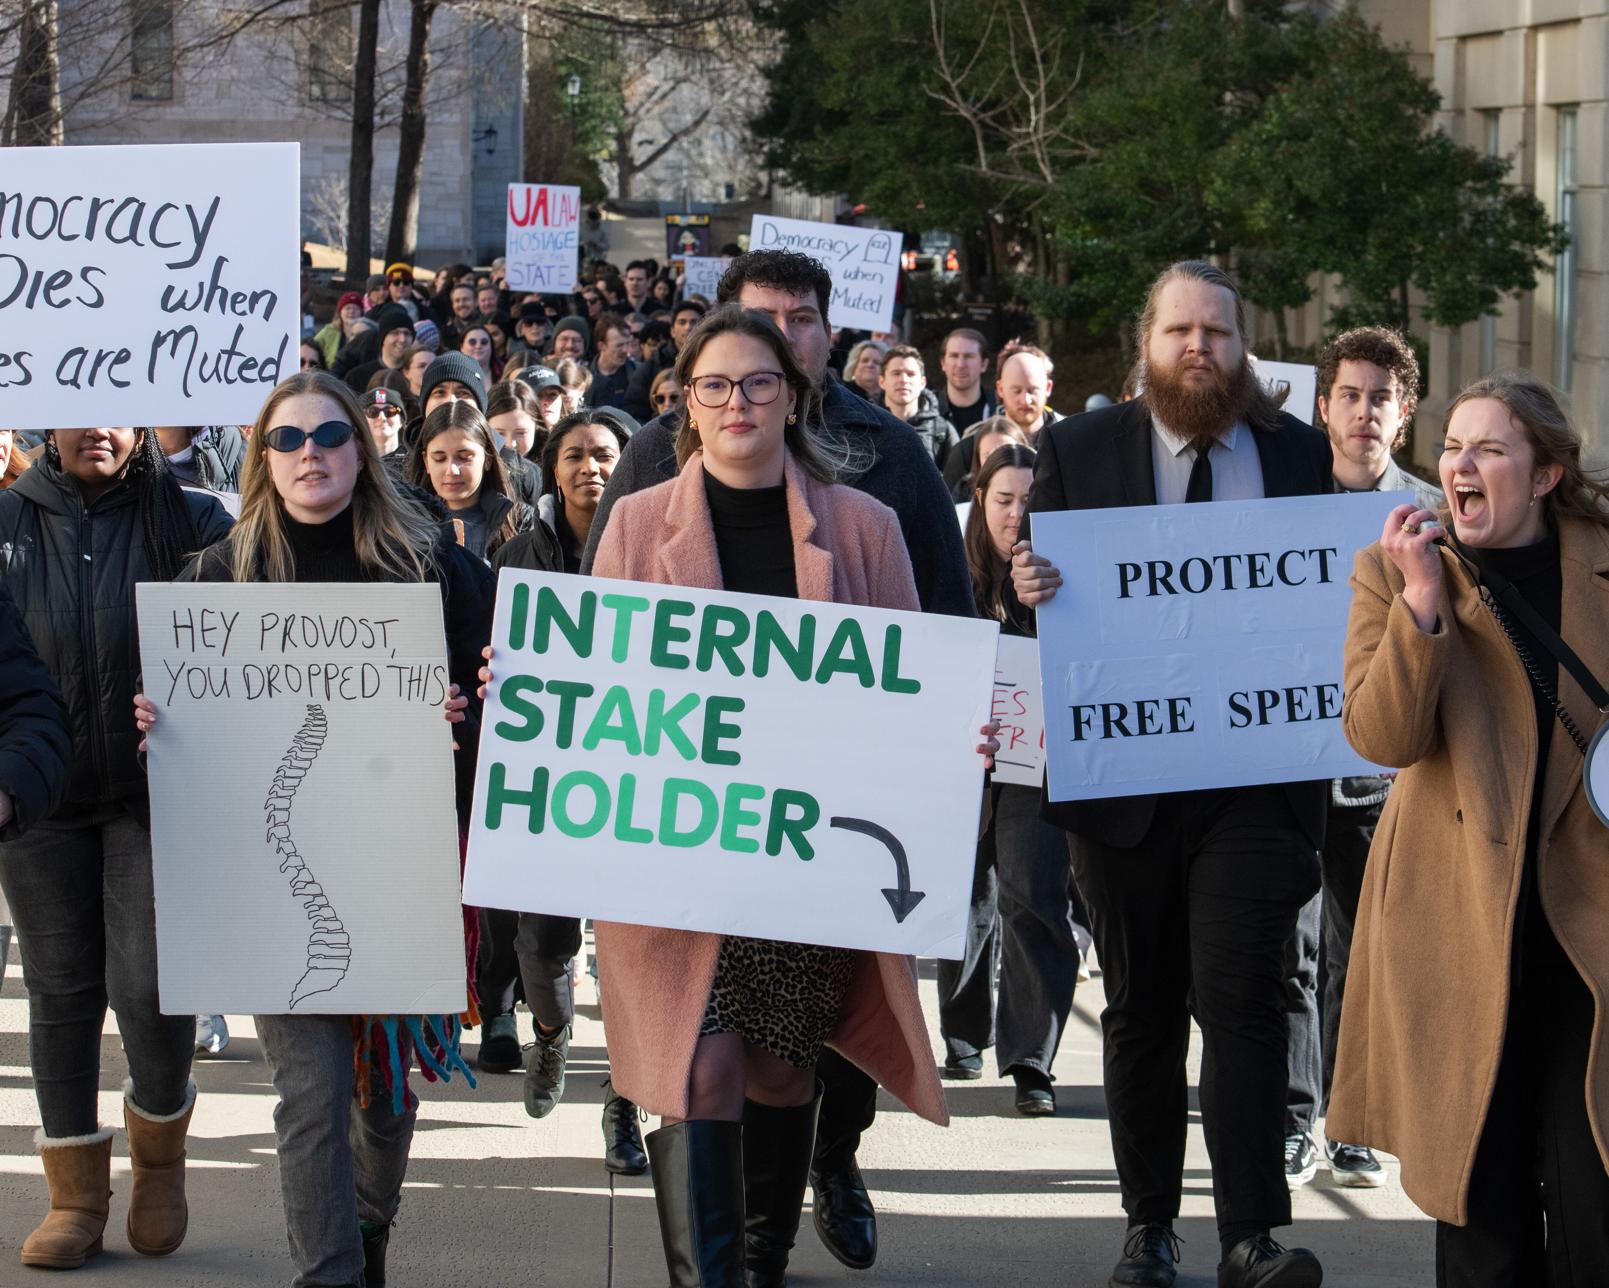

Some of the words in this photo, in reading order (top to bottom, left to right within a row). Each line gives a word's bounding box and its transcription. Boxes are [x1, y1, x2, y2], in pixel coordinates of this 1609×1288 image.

[509, 186, 549, 228] UA
[551, 191, 580, 228] LAW
[509, 231, 578, 255] HOSTAGE
[761, 222, 859, 262] Democracy
[160, 256, 278, 322] when
[509, 262, 573, 288] STATE
[843, 266, 884, 285] when
[831, 287, 883, 315] Muted
[56, 346, 132, 390] are
[148, 323, 289, 398] Muted
[1115, 547, 1338, 600] PROTECT
[173, 608, 239, 657] HEY
[261, 612, 399, 658] PROVOST,
[508, 582, 922, 694] INTERNAL
[163, 659, 231, 706] YOU
[243, 662, 381, 702] DROPPED
[387, 664, 446, 706] THIS
[494, 674, 746, 767] STAKE
[1068, 696, 1196, 743] FREE
[1229, 683, 1345, 730] SPEE
[484, 762, 821, 863] HOLDER
